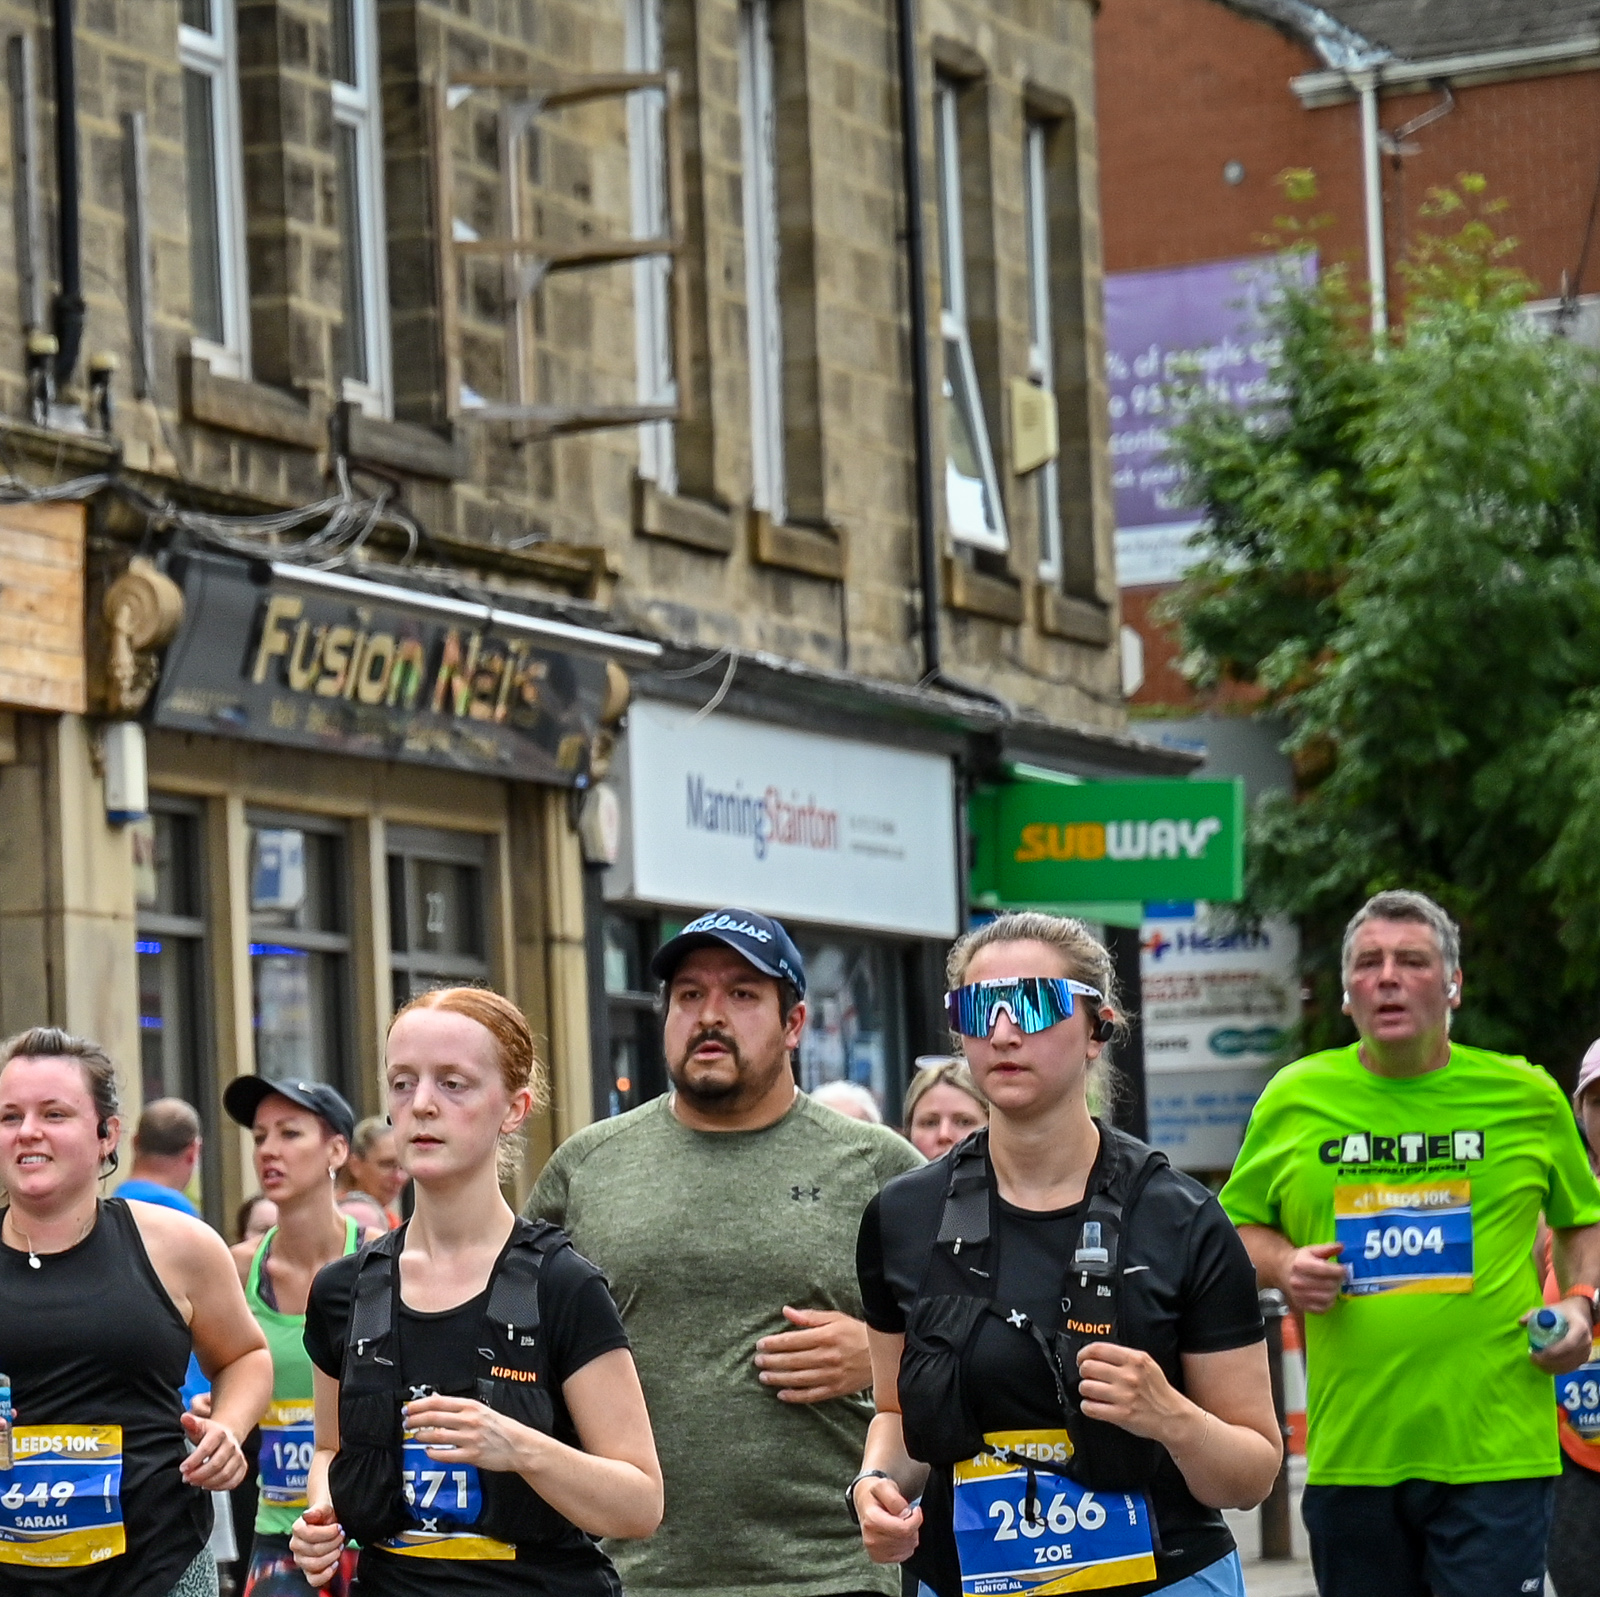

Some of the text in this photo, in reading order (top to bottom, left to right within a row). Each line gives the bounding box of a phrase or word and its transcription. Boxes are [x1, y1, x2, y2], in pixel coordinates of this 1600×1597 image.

[252, 596, 426, 709] Fusion
[1014, 816, 1221, 863] SUBWAY
[1319, 1130, 1485, 1165] CARTER
[1364, 1226, 1444, 1260] 5004
[1067, 1318, 1112, 1335] EVADICT
[491, 1365, 537, 1383] KIPRUN
[12, 1436, 100, 1452] LEEDS 10K
[1, 1481, 75, 1510] 649
[15, 1513, 68, 1529] SARAH
[989, 1492, 1107, 1541] 2866
[1033, 1544, 1073, 1564] ZOE
[974, 1580, 1022, 1593] RUN FOR ALL
